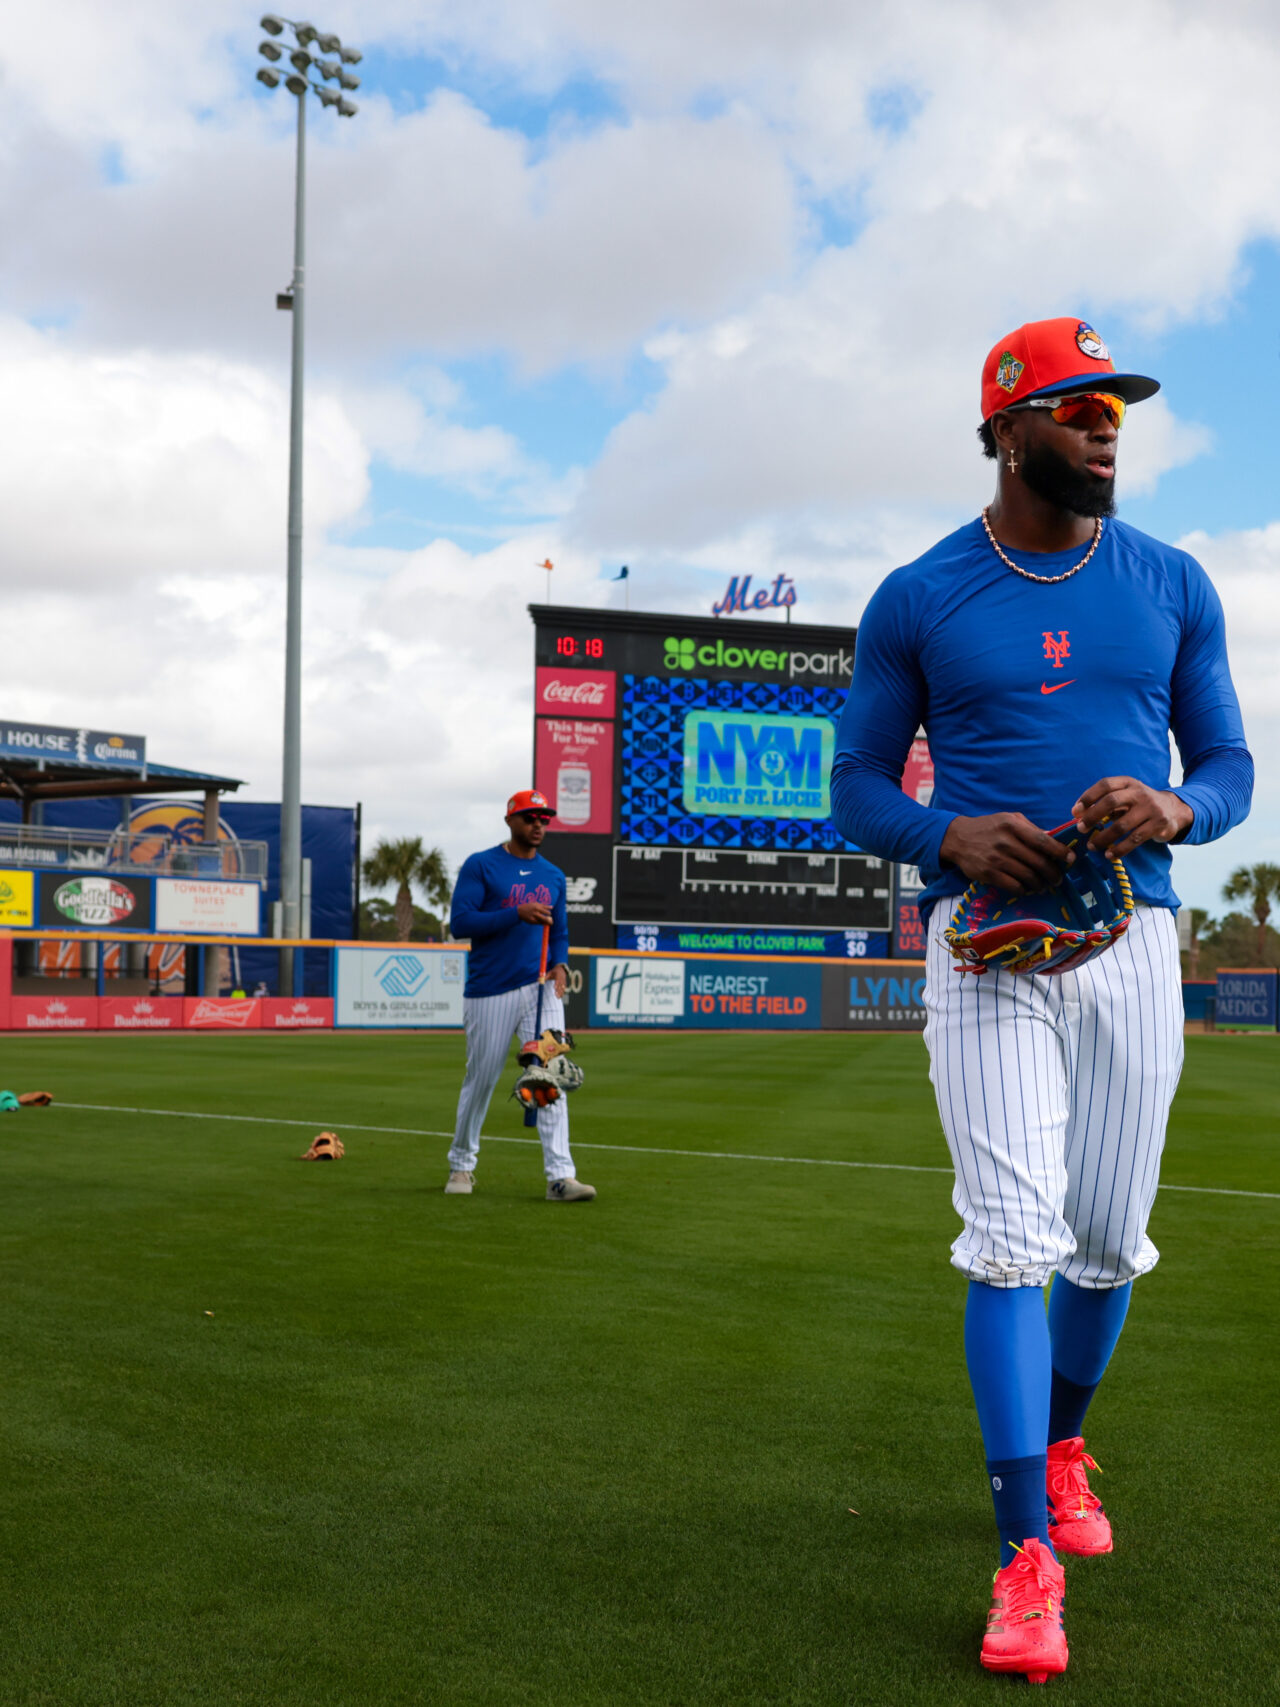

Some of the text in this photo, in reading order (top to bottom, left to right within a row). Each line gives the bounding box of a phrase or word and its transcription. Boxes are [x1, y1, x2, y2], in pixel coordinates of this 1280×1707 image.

[712, 573, 798, 616] Mets
[556, 636, 604, 658] 10:18
[7, 730, 71, 752] HOUSE
[553, 732, 572, 744] For
[94, 742, 138, 760] Corona
[697, 721, 823, 790] NYM
[695, 785, 822, 808] PORT ST. LUCIE
[694, 850, 718, 862] BALL
[747, 852, 778, 865] STRIKE
[173, 882, 245, 896] TOWNEPLACE
[502, 884, 552, 908] Mets
[193, 896, 225, 905] SUITES
[75, 905, 117, 919] PIZZA
[637, 936, 657, 952] $0
[678, 932, 826, 952] WELCOME TO CLOVER PARK
[847, 941, 866, 957] $0
[644, 982, 681, 996] Express
[690, 974, 769, 995] NEAREST
[690, 994, 807, 1015] TO THE FIELD
[27, 1013, 87, 1027] Budweiser
[113, 1013, 171, 1027] Budweiser
[275, 1013, 325, 1026] Budweiser
[849, 1010, 881, 1020] REAL
